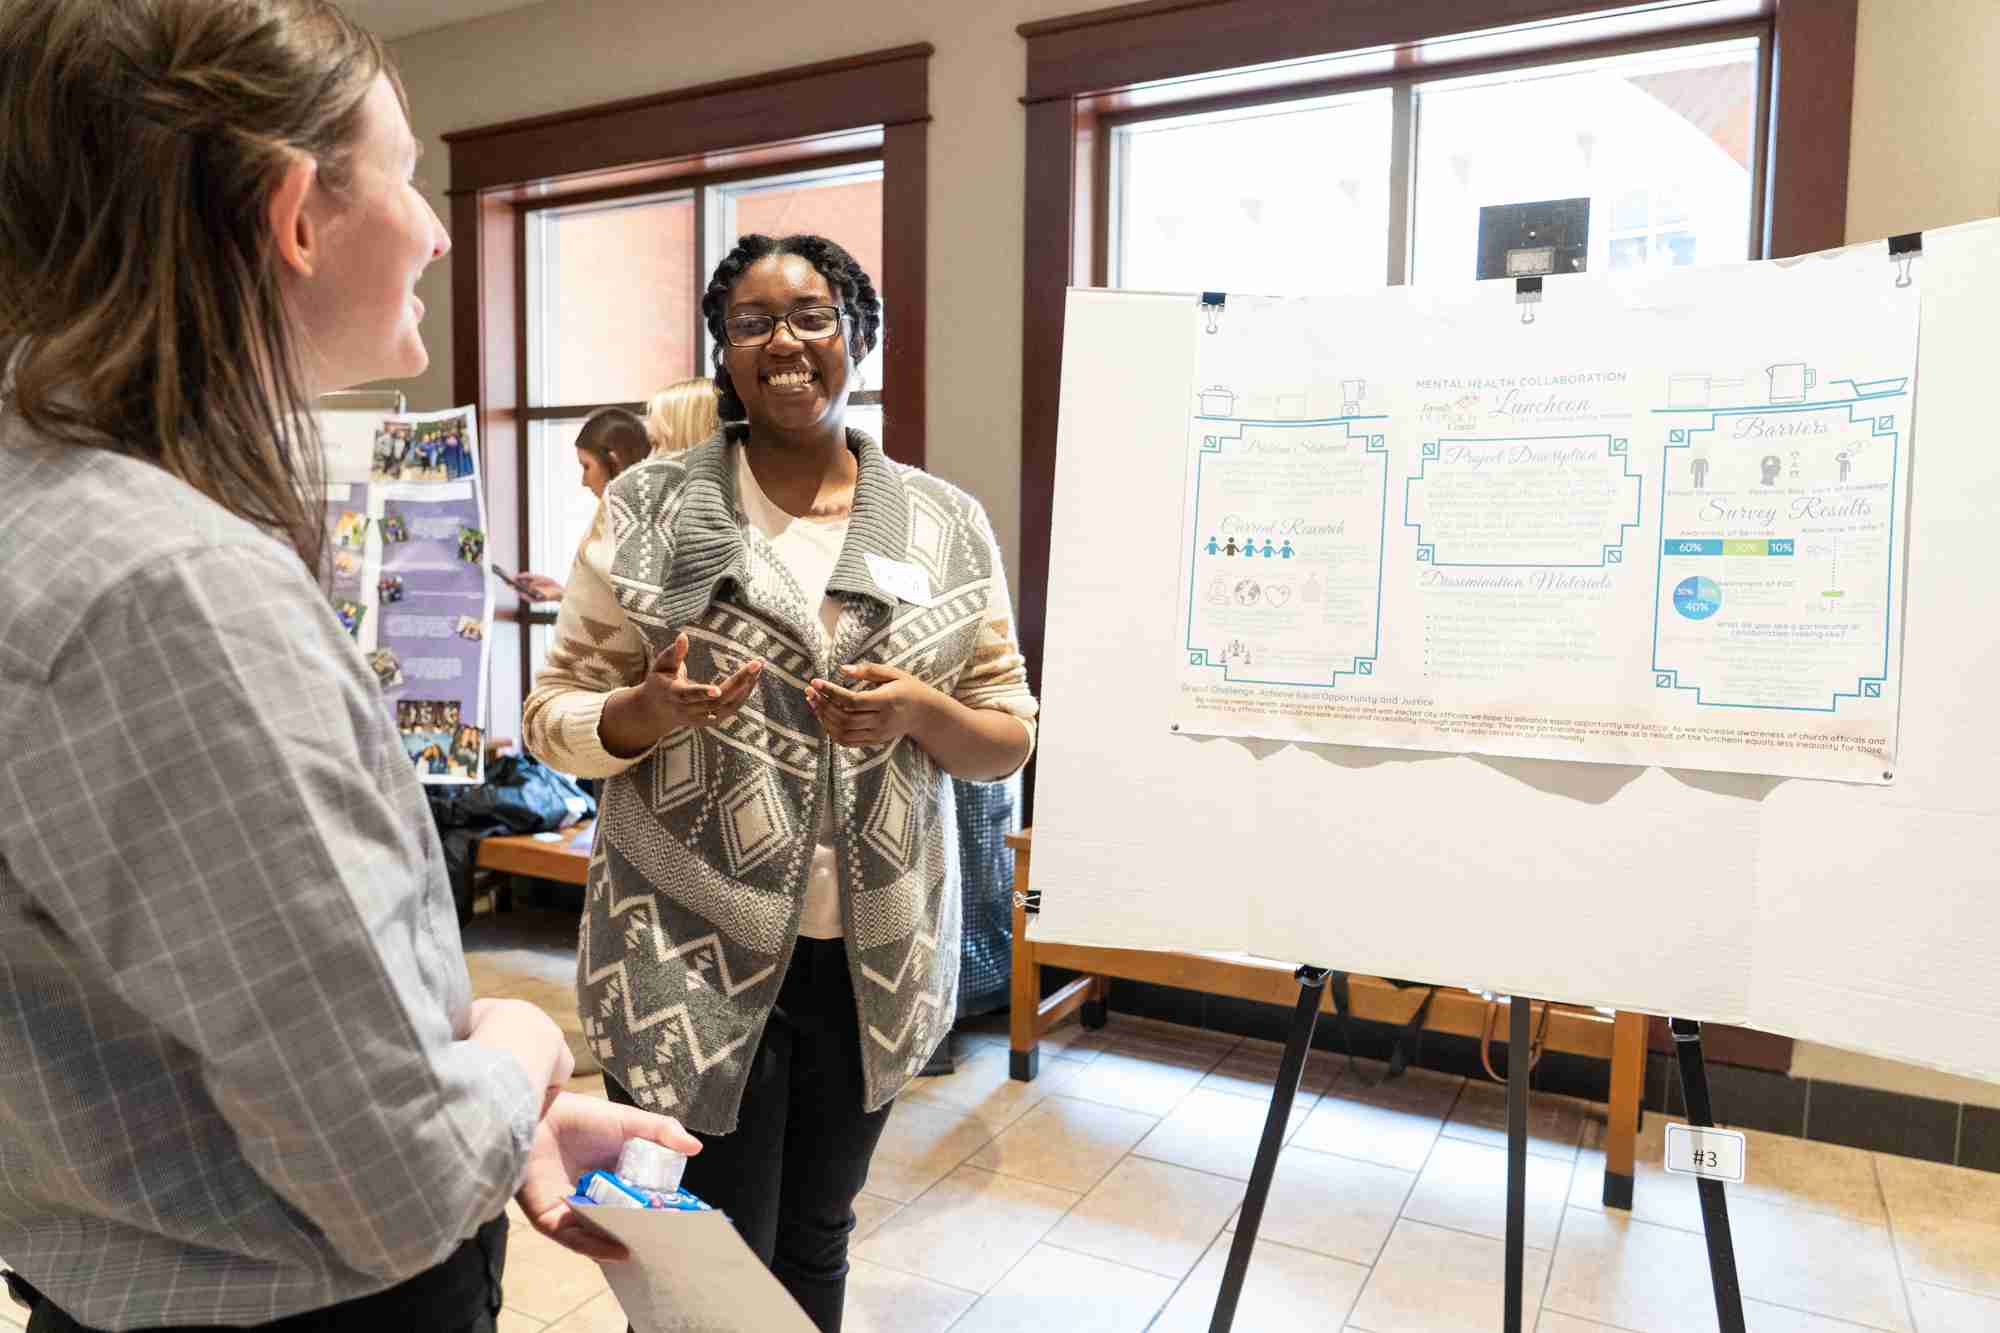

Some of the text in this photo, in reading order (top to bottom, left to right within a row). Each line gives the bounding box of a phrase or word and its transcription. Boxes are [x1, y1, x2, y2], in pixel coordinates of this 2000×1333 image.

[1416, 372, 1627, 389] MENTAL HEALTH COLLABORATION
[1488, 388, 1591, 418] Luncheon
[1732, 416, 1829, 440] Barriers
[1444, 445, 1503, 470] Project
[1698, 497, 1872, 527] Survey Results
[1679, 543, 1703, 552] 60%
[1771, 543, 1793, 552] 10%
[1685, 601, 1709, 612] 40%
[1321, 692, 1378, 705] Opportunity
[1380, 695, 1398, 704] and
[1401, 696, 1434, 706] Justice
[1601, 728, 1629, 737] create
[1687, 733, 1701, 741] the
[1703, 734, 1743, 744] luncheon
[1796, 741, 1839, 752] inequality
[1842, 743, 1854, 751] for
[1857, 744, 1882, 754] those
[1737, 729, 1785, 739] awareness
[1787, 731, 1797, 739] of
[1799, 732, 1828, 741] church
[1830, 734, 1865, 744] officials
[1868, 737, 1886, 746] and
[1693, 1149, 1718, 1168] #3
